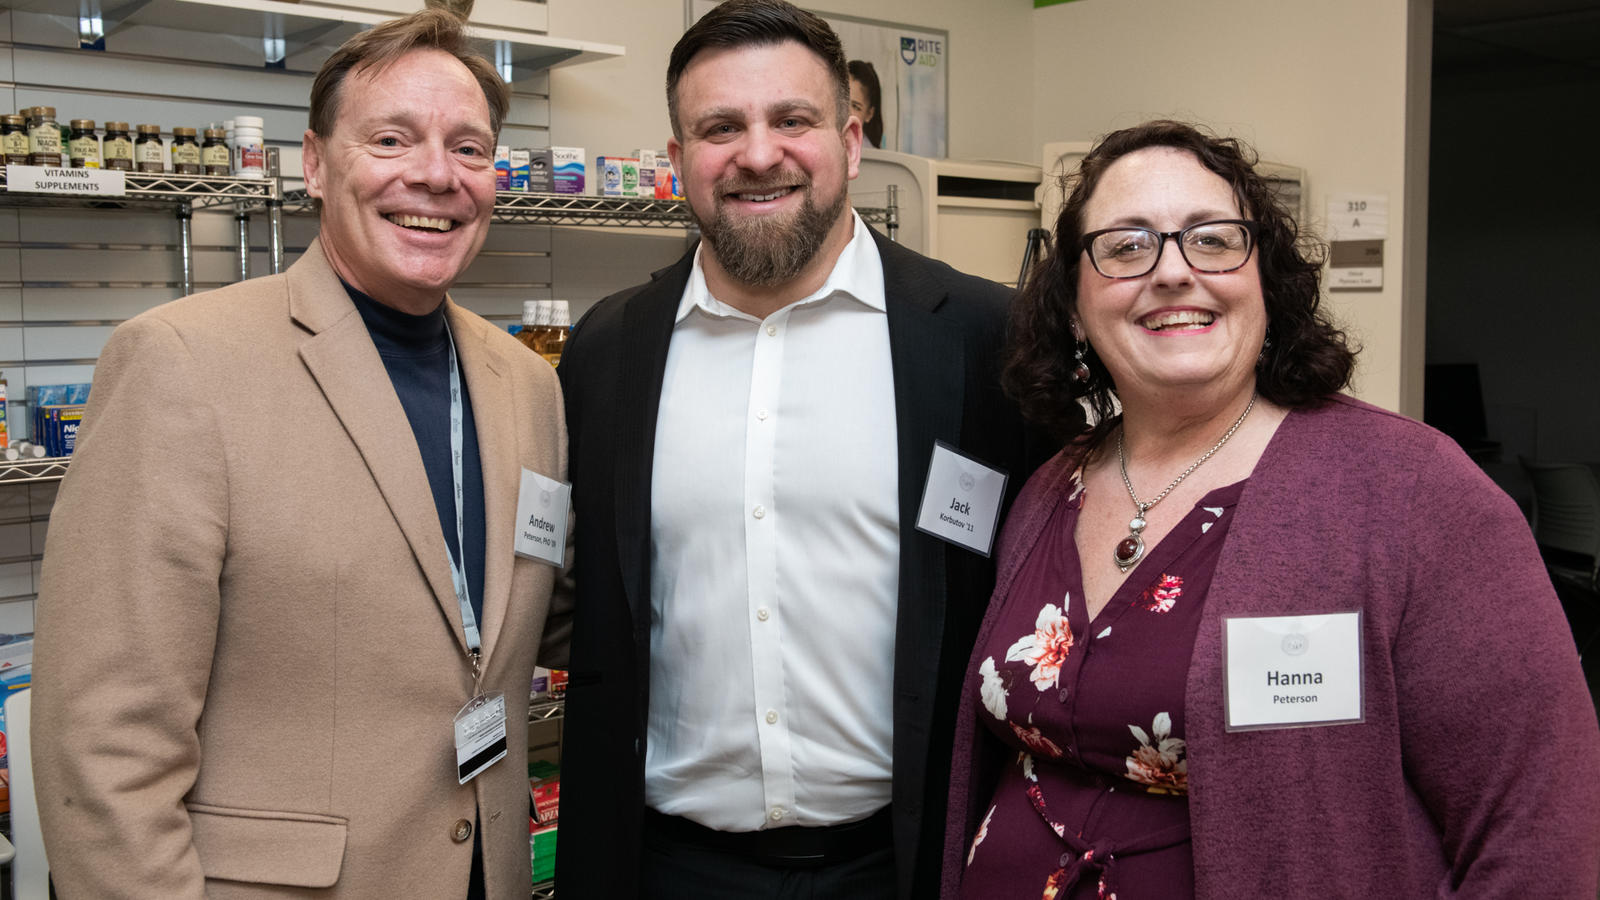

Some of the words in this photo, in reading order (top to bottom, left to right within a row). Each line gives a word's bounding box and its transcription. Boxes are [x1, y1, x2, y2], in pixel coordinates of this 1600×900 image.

[918, 39, 941, 55] RITE
[919, 53, 936, 67] AID
[554, 152, 578, 160] Soothe
[44, 169, 89, 178] VITAMINS
[35, 181, 100, 191] SUPPLEMENTS
[1347, 201, 1367, 213] 310
[1352, 218, 1361, 228] A
[949, 497, 971, 516] Jack
[528, 514, 556, 533] Andrew
[939, 512, 966, 529] Korbutov
[1267, 671, 1323, 686] Hanna
[1273, 694, 1318, 704] Peterson
